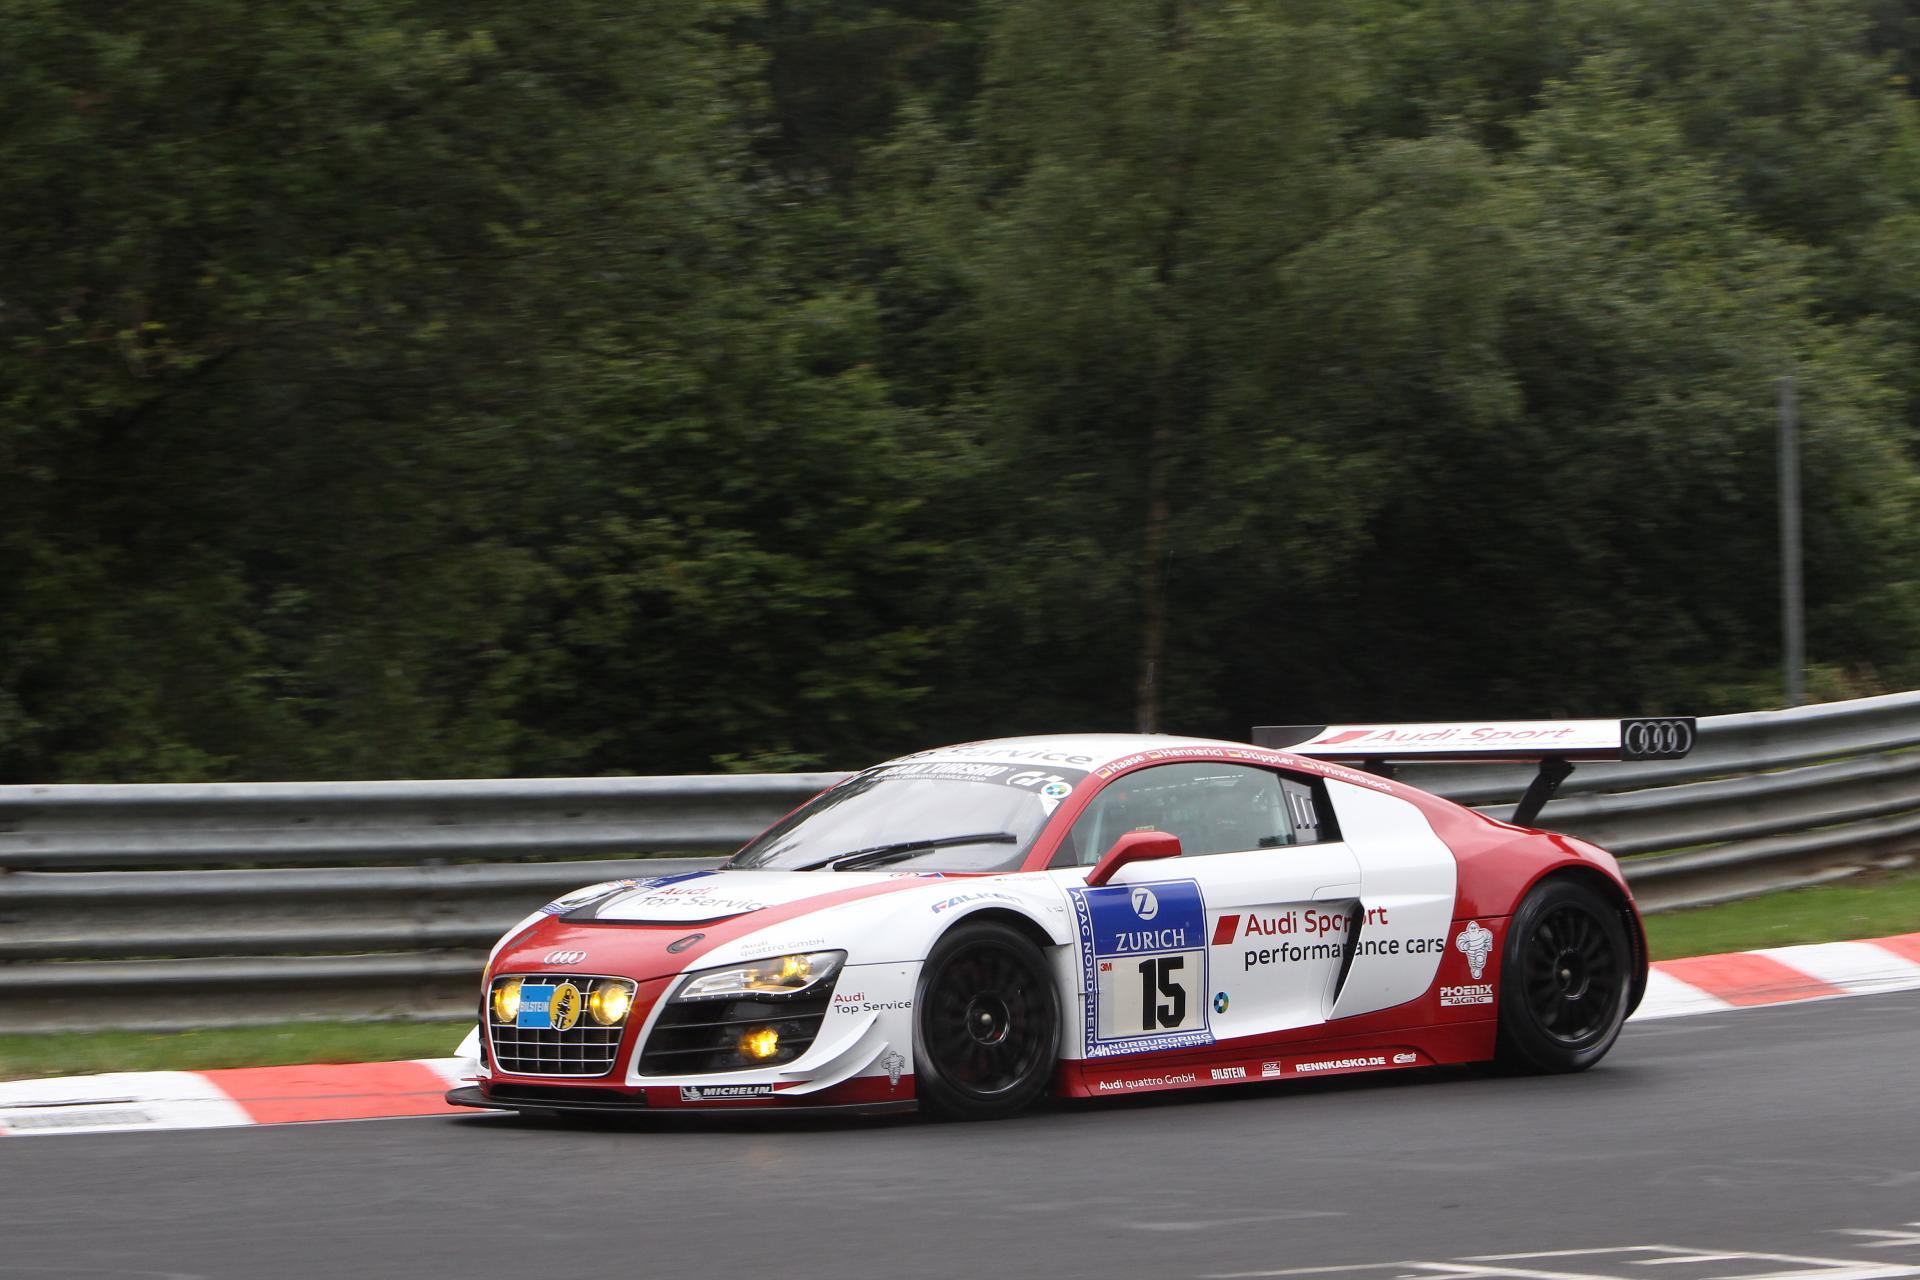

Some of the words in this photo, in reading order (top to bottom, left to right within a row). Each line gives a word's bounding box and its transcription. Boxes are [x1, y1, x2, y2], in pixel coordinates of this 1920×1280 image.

[1366, 728, 1462, 742] Audi
[1460, 727, 1575, 742] Sport
[1159, 748, 1224, 758] Hennerici
[1240, 750, 1295, 766] Stippler
[1107, 754, 1145, 773] Haase
[1071, 890, 1090, 937] ADAC
[1244, 911, 1297, 937] Audi
[1115, 928, 1186, 951] ZURICH
[1406, 937, 1444, 953] cars
[1100, 963, 1112, 972] 3M
[834, 992, 865, 1003] Audi
[1139, 956, 1186, 1031] 15
[519, 1001, 549, 1013] BILSTEIN
[834, 1004, 859, 1014] Top
[863, 1000, 912, 1011] Service
[1109, 1033, 1212, 1050] NÜRBURGRING
[1109, 1038, 1213, 1056] NORDSCHLEIFE
[1087, 1044, 1110, 1058] 24h
[1295, 1056, 1387, 1073] RENNKASKO.DE
[1211, 1066, 1247, 1080] BILSTEIN
[1099, 1079, 1123, 1091] Audi
[1126, 1076, 1163, 1089] quattro
[1165, 1072, 1196, 1084] GmbH
[703, 1086, 771, 1096] MICHELIN
